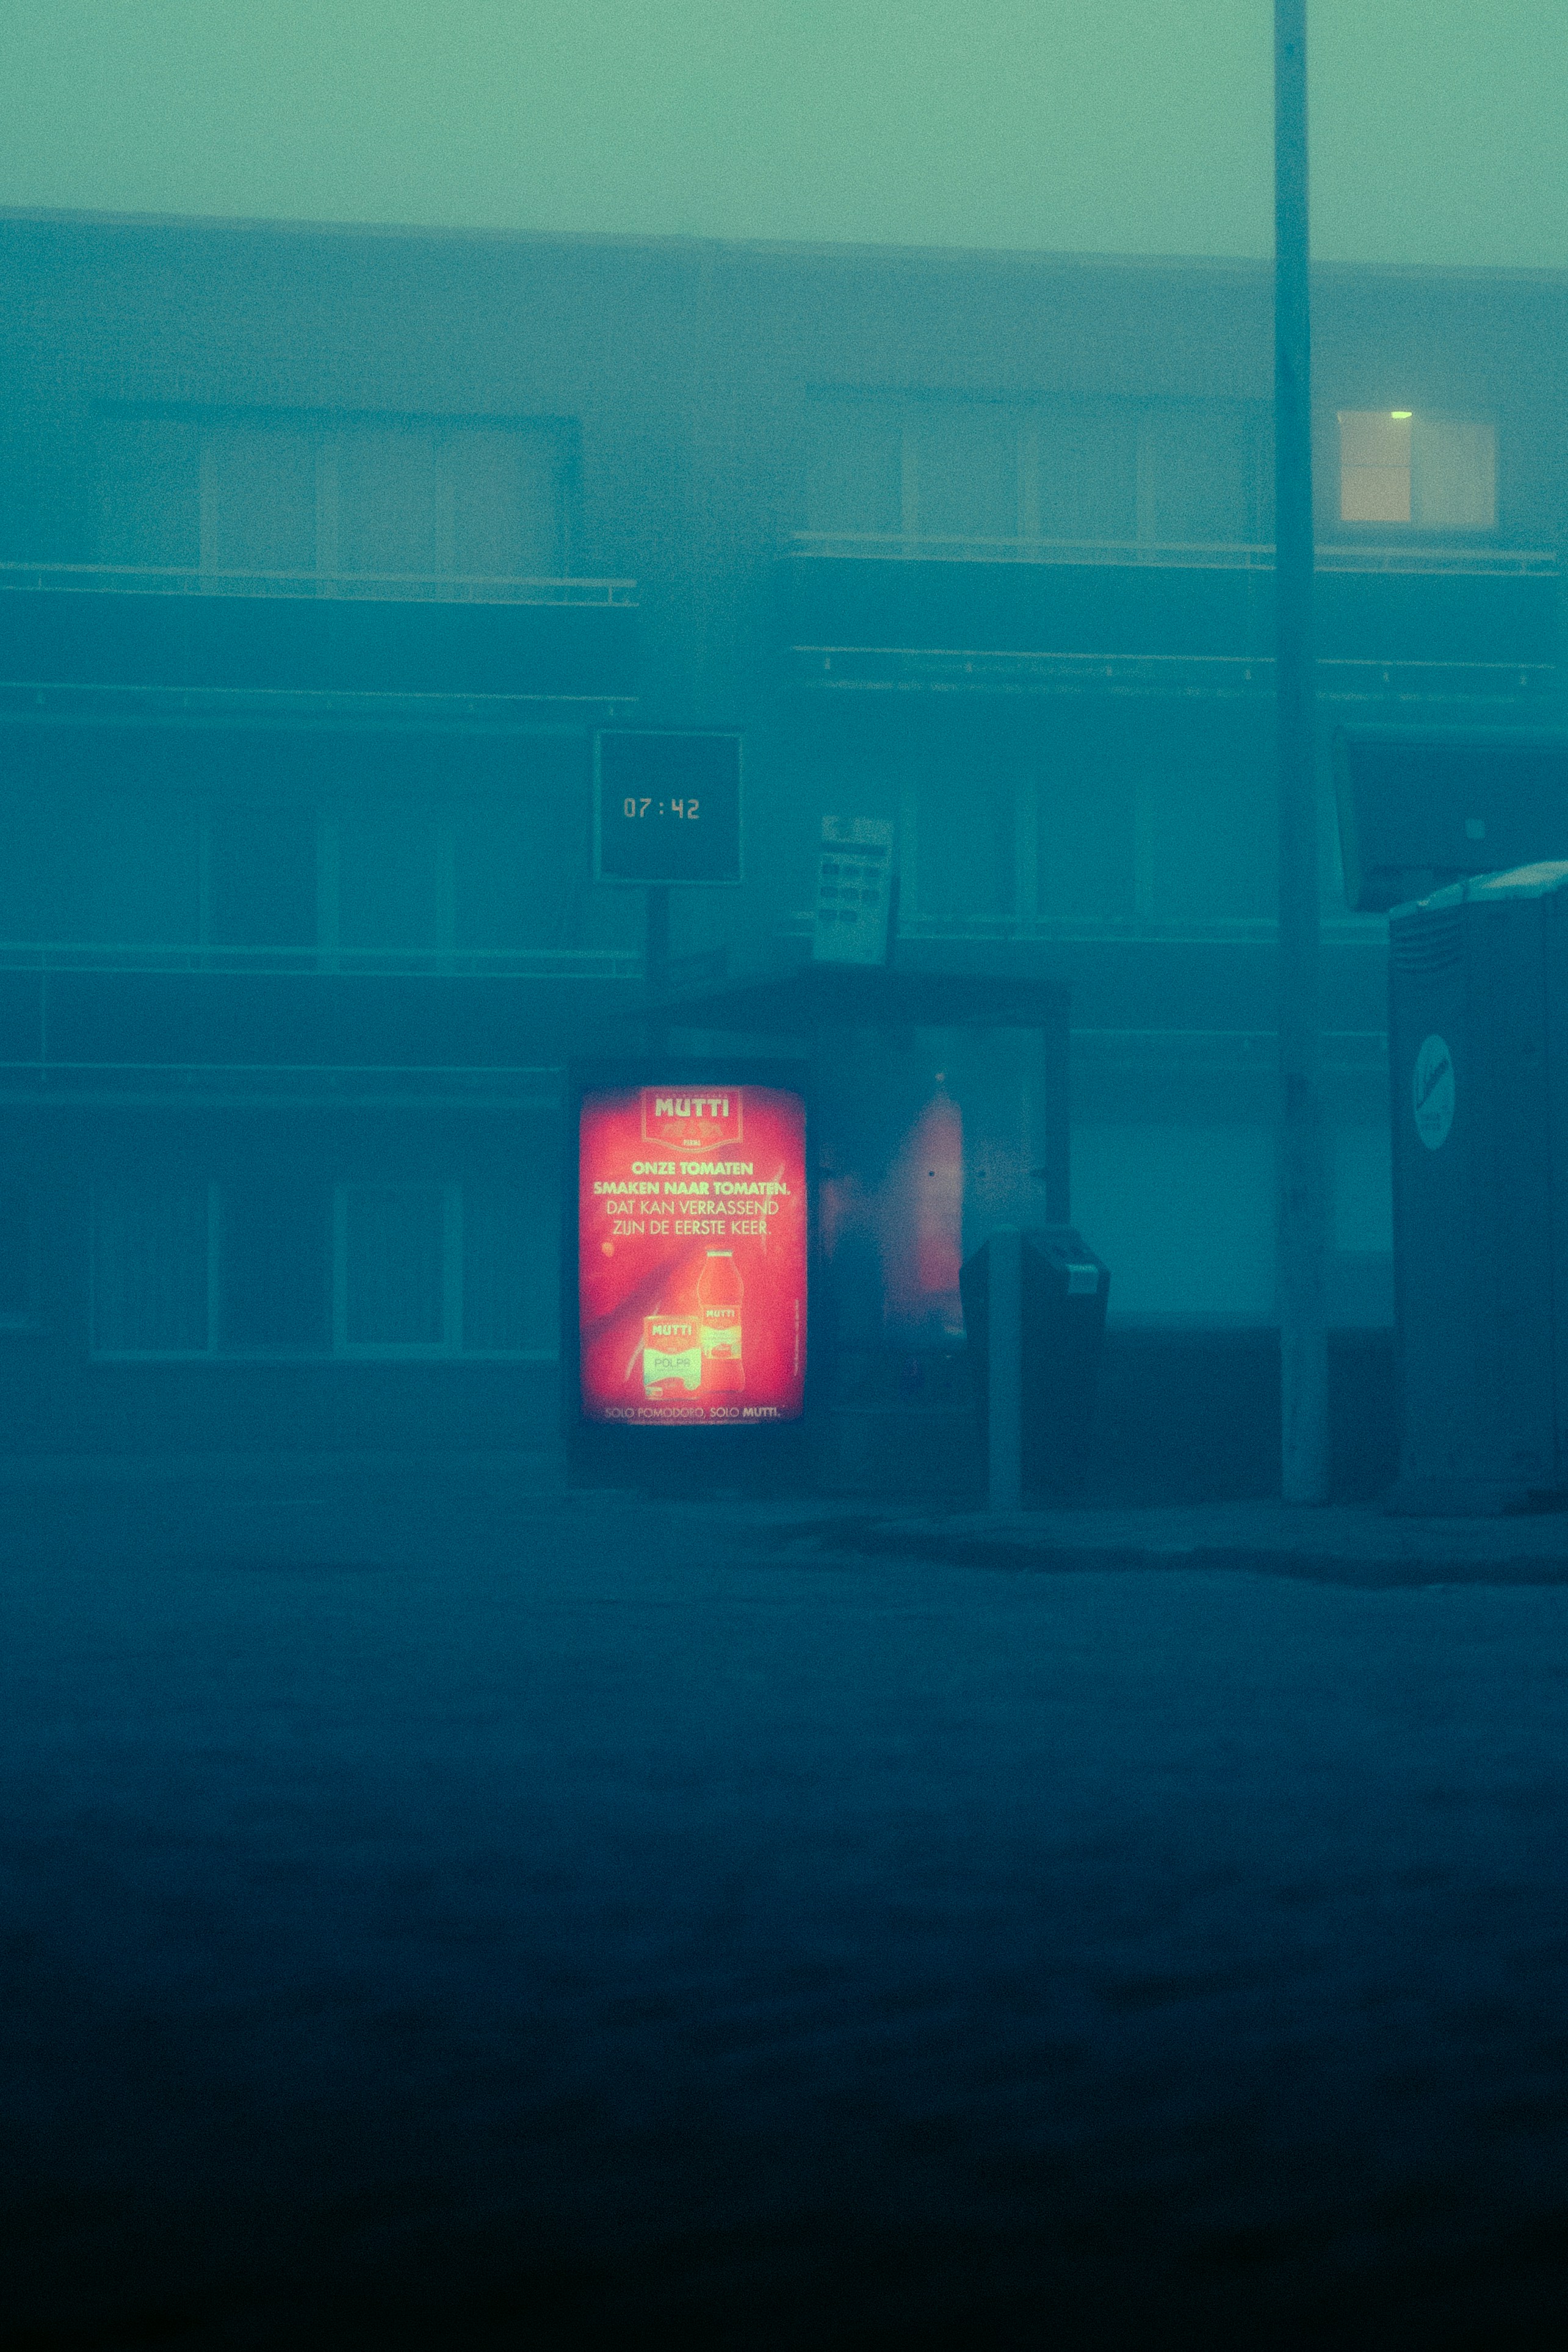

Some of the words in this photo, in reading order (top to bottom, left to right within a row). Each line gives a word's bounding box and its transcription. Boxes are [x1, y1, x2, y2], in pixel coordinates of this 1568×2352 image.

[624, 798, 699, 819] 07:42
[655, 1099, 729, 1116] MUTTI
[632, 1162, 675, 1176] ONZE
[680, 1162, 753, 1176] TOMATEN
[593, 1182, 659, 1195] SMAKEN
[665, 1182, 709, 1195] NAAR
[714, 1182, 791, 1195] TOMATEN.
[607, 1201, 635, 1215] DAT
[640, 1201, 674, 1215] KAN
[679, 1201, 779, 1215] VERRASSEND
[613, 1221, 645, 1236] ZIJN
[650, 1221, 670, 1235] DE
[675, 1221, 725, 1235] EERSTE
[732, 1221, 771, 1235] KEER.
[652, 1325, 692, 1336] MUTTI
[654, 1358, 690, 1367] POLPA
[605, 1408, 635, 1417] SOLO
[638, 1407, 706, 1419] POMODORO,
[710, 1407, 739, 1417] SOLO
[743, 1406, 781, 1417] MUTTI.
